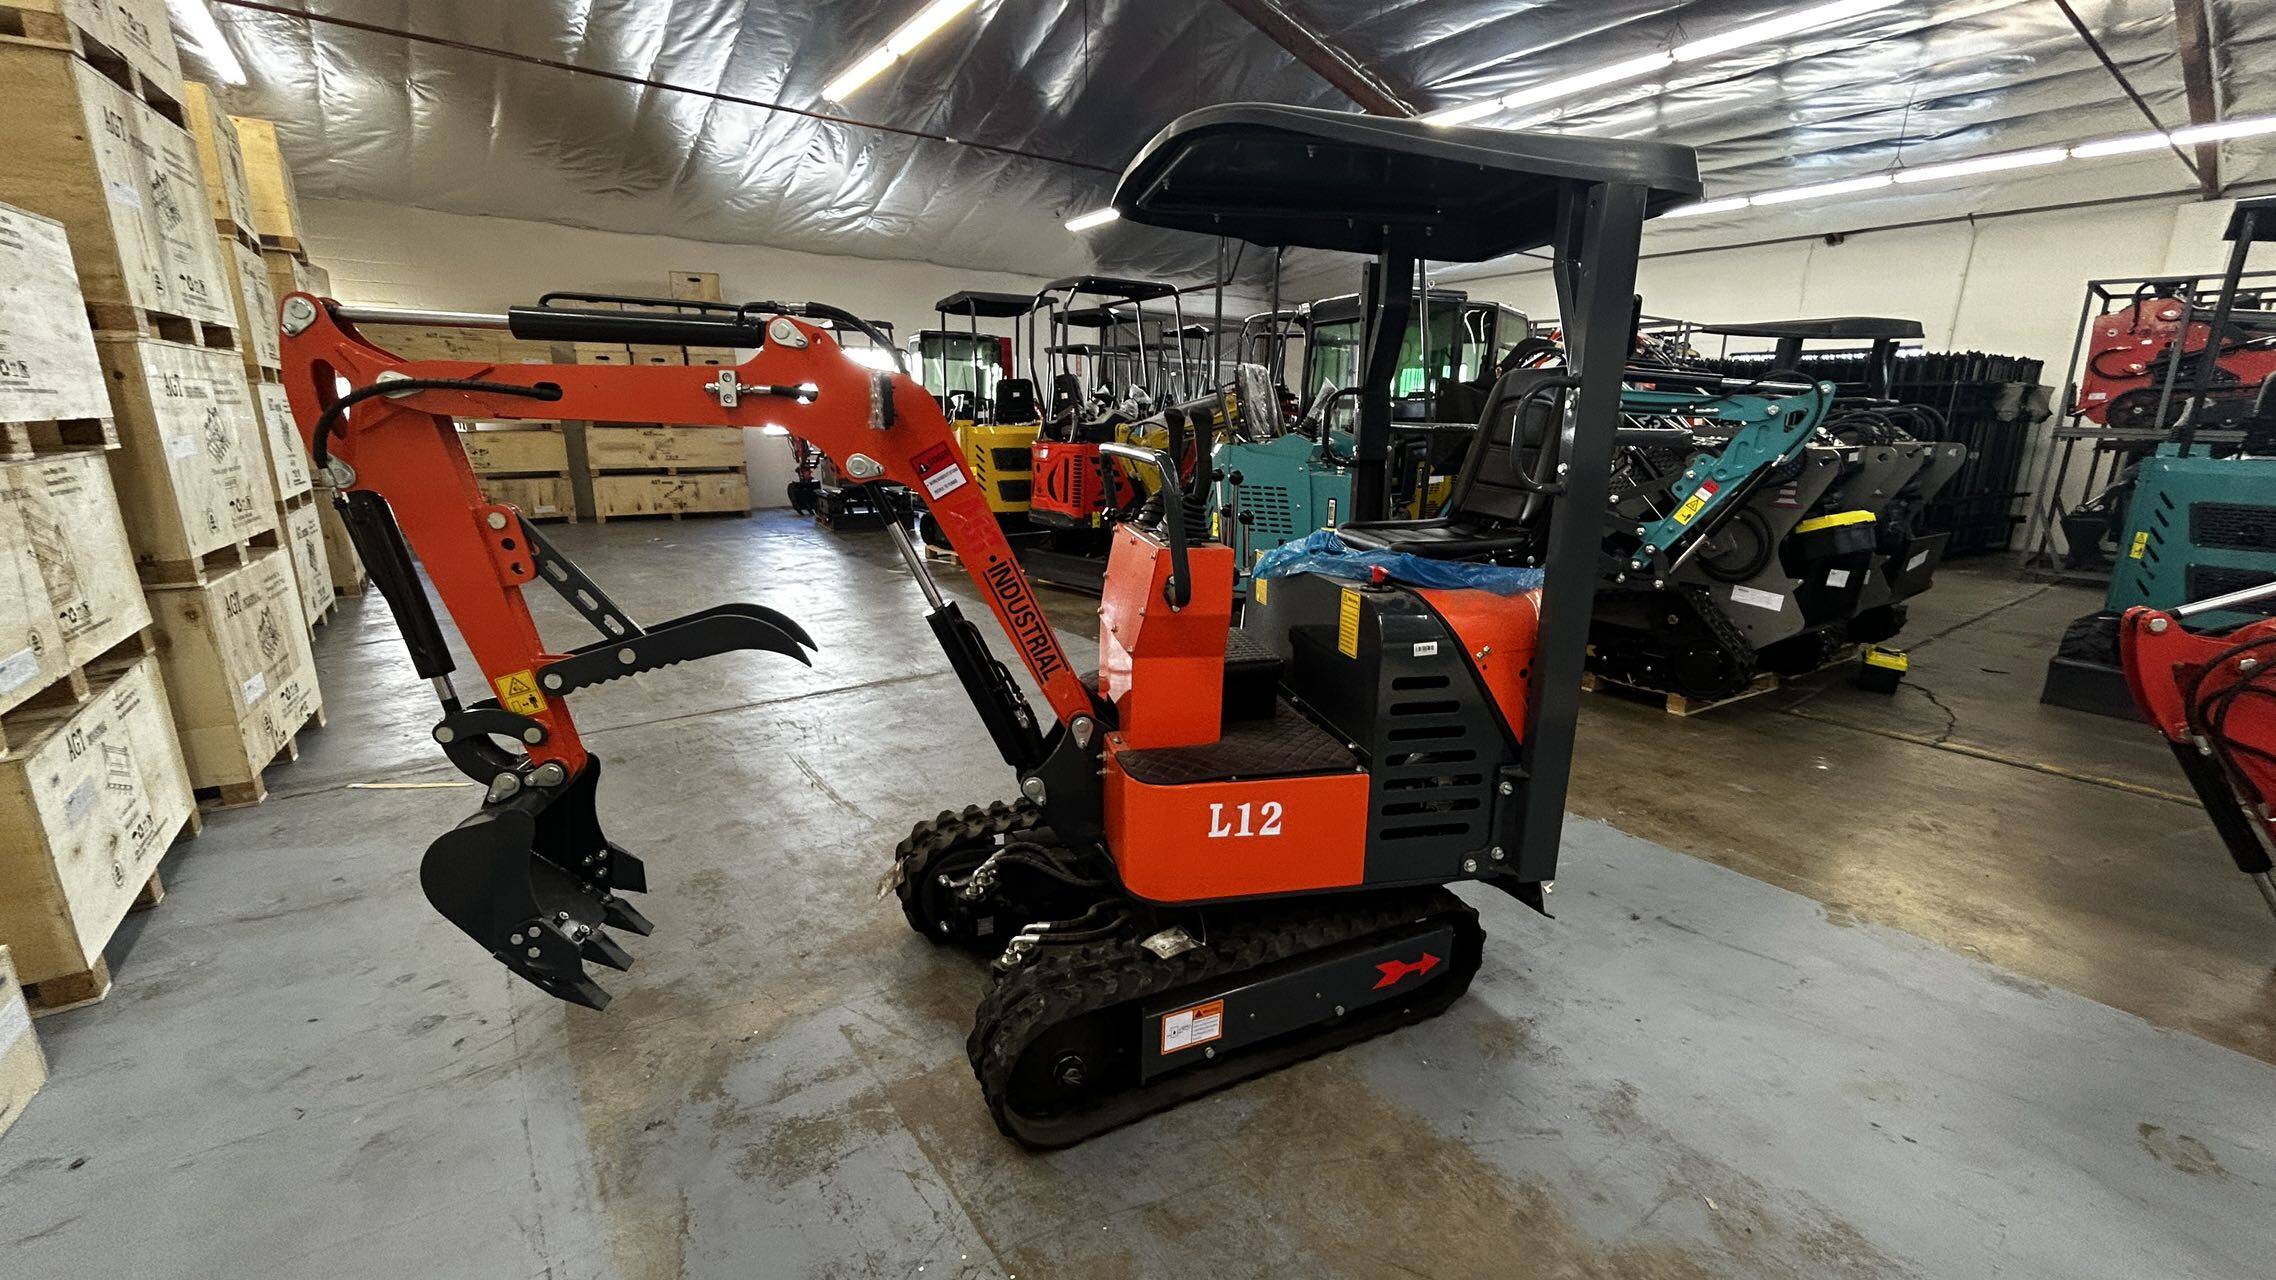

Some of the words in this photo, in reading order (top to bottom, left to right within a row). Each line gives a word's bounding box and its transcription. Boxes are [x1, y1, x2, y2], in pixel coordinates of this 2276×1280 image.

[103, 106, 126, 142] AGT
[164, 373, 184, 397] AGT
[225, 592, 242, 618] AGT
[987, 559, 1062, 681] INDUSTRIAL
[65, 728, 87, 762] AGT
[1208, 801, 1283, 838] L12
